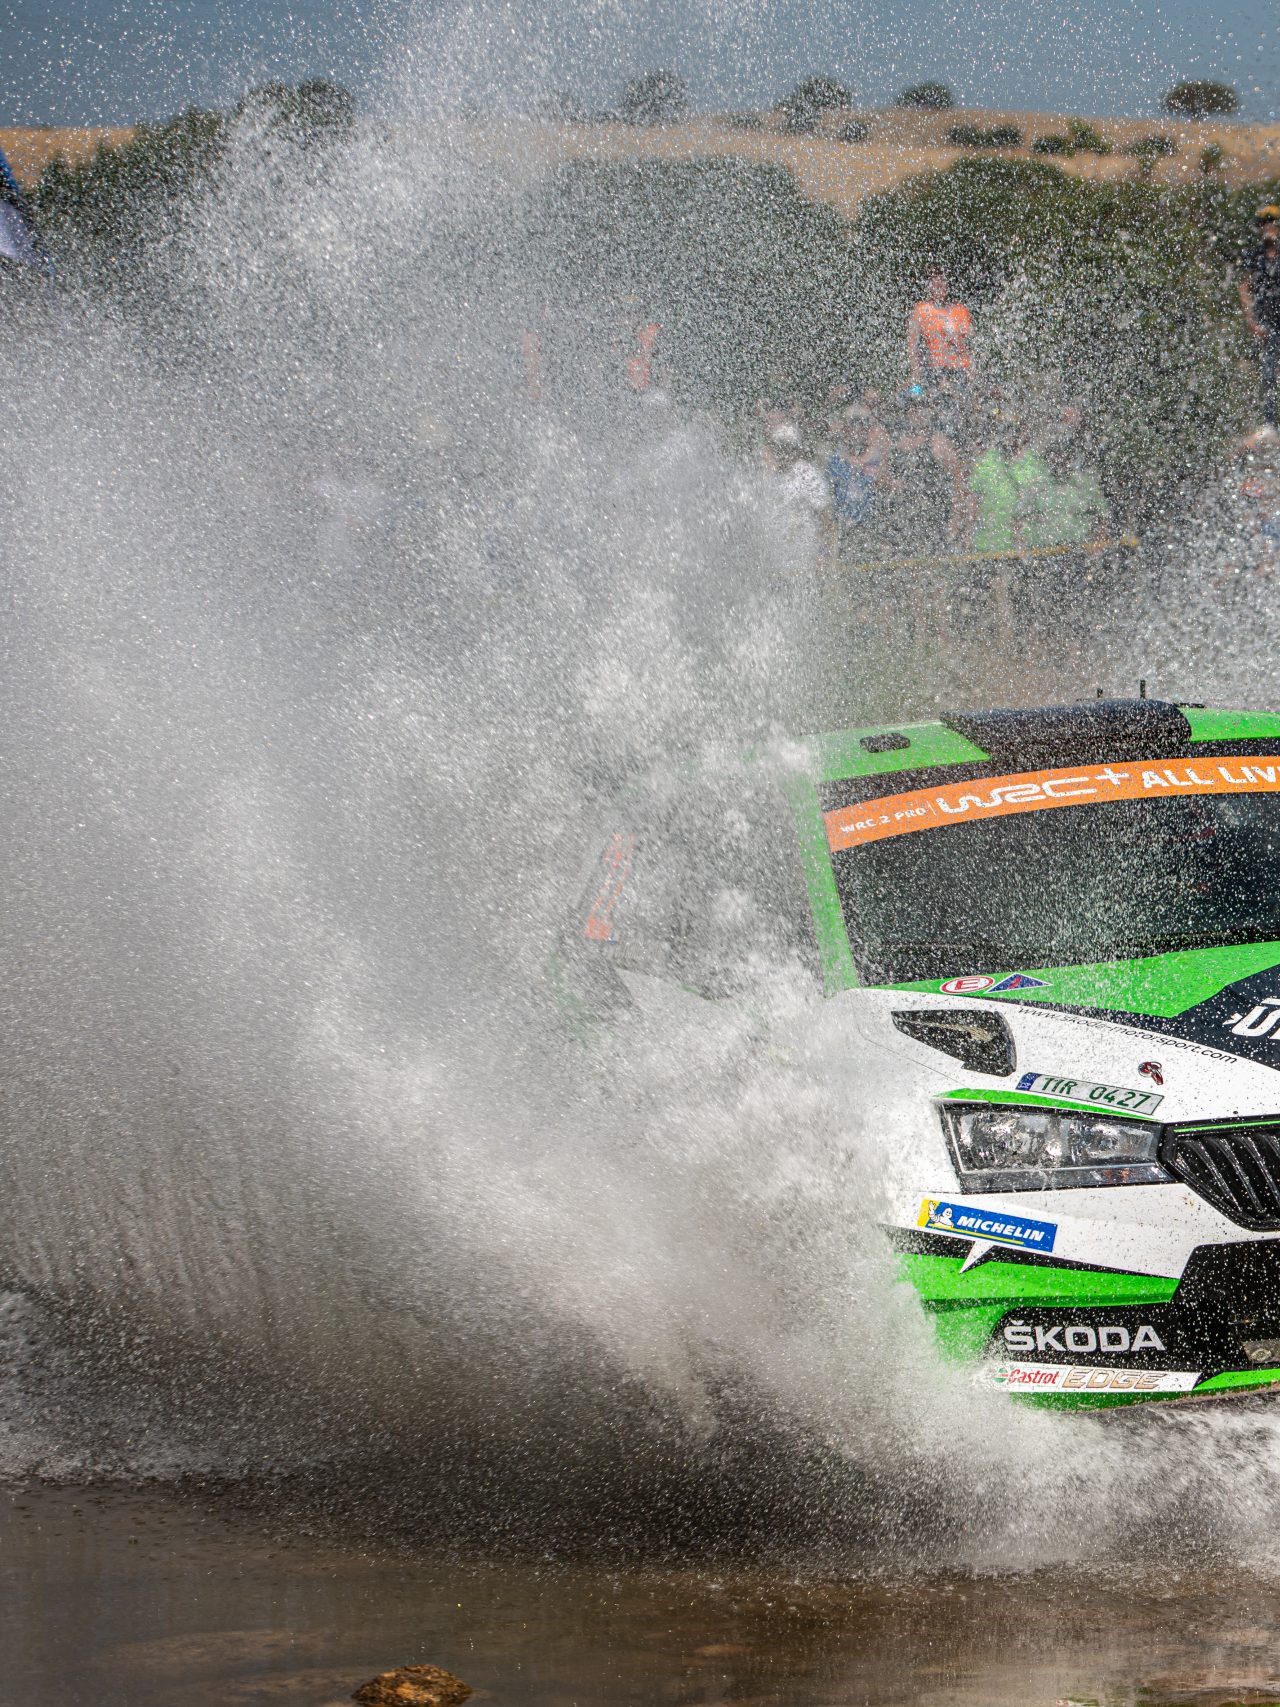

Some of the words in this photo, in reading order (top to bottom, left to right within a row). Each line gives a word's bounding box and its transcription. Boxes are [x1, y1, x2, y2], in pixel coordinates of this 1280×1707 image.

[1141, 767, 1215, 789] ALL
[840, 818, 877, 832] WRC
[879, 815, 891, 824] 2
[894, 807, 927, 820] PRO
[1088, 1086, 1151, 1109] 0427
[956, 1216, 1045, 1242] MICHELIN
[1003, 1319, 1166, 1351] ŠKODA
[1061, 1367, 1167, 1390] EDGE
